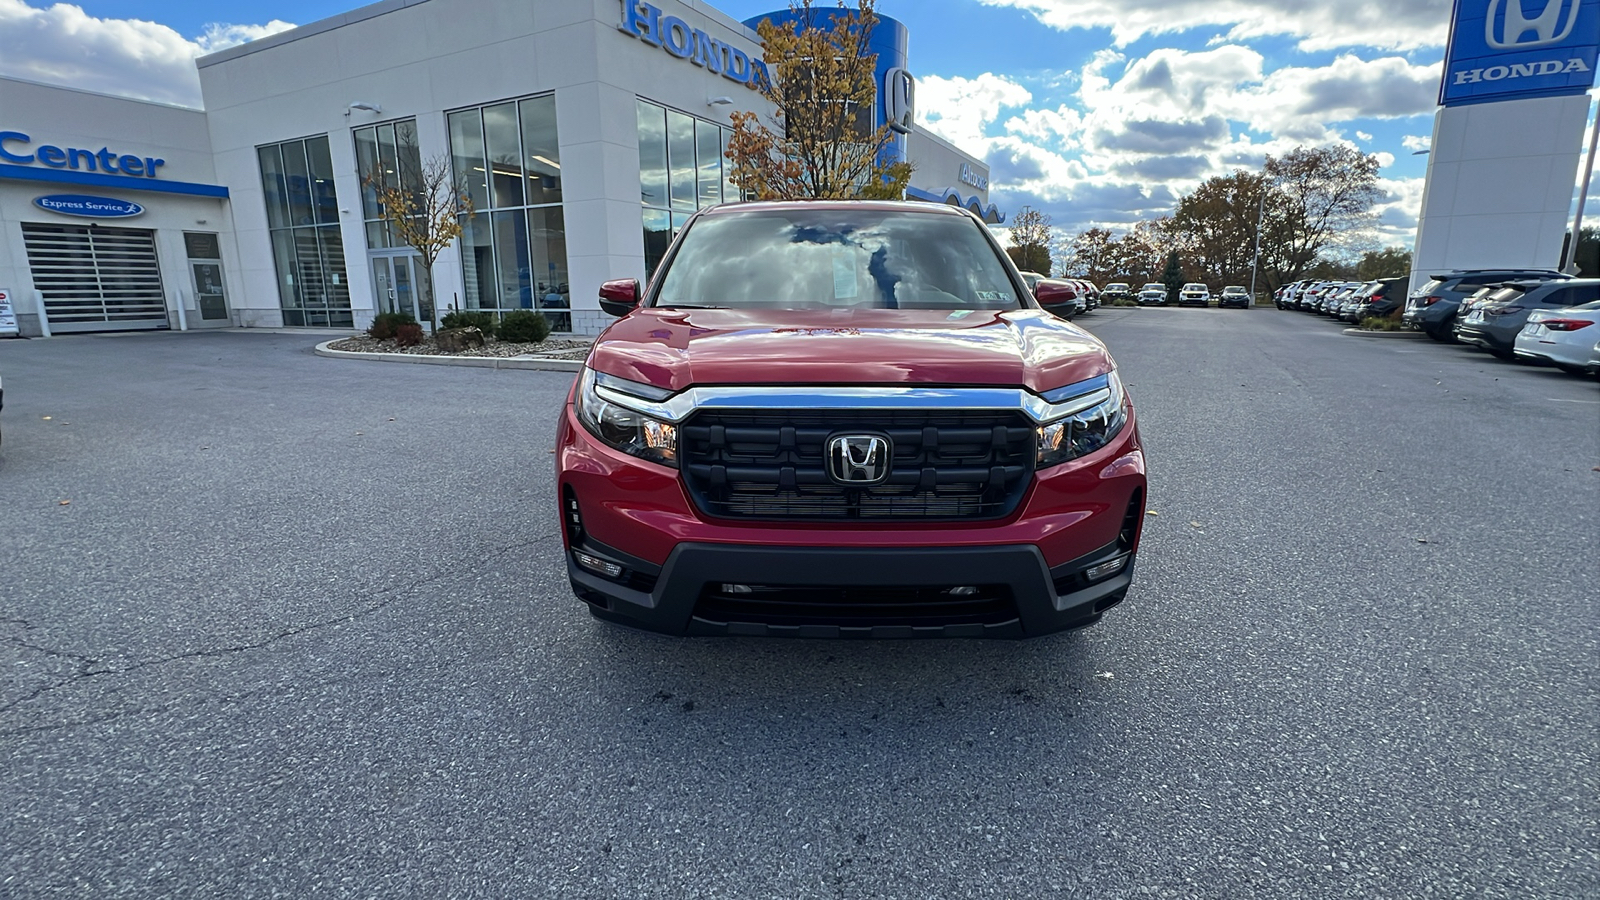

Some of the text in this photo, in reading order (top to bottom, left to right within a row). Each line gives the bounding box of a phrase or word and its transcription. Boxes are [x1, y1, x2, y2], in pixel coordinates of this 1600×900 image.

[618, 0, 773, 92] HONDA
[1453, 57, 1591, 85] HONDA
[0, 131, 165, 177] Center
[42, 199, 123, 211] Express Service
